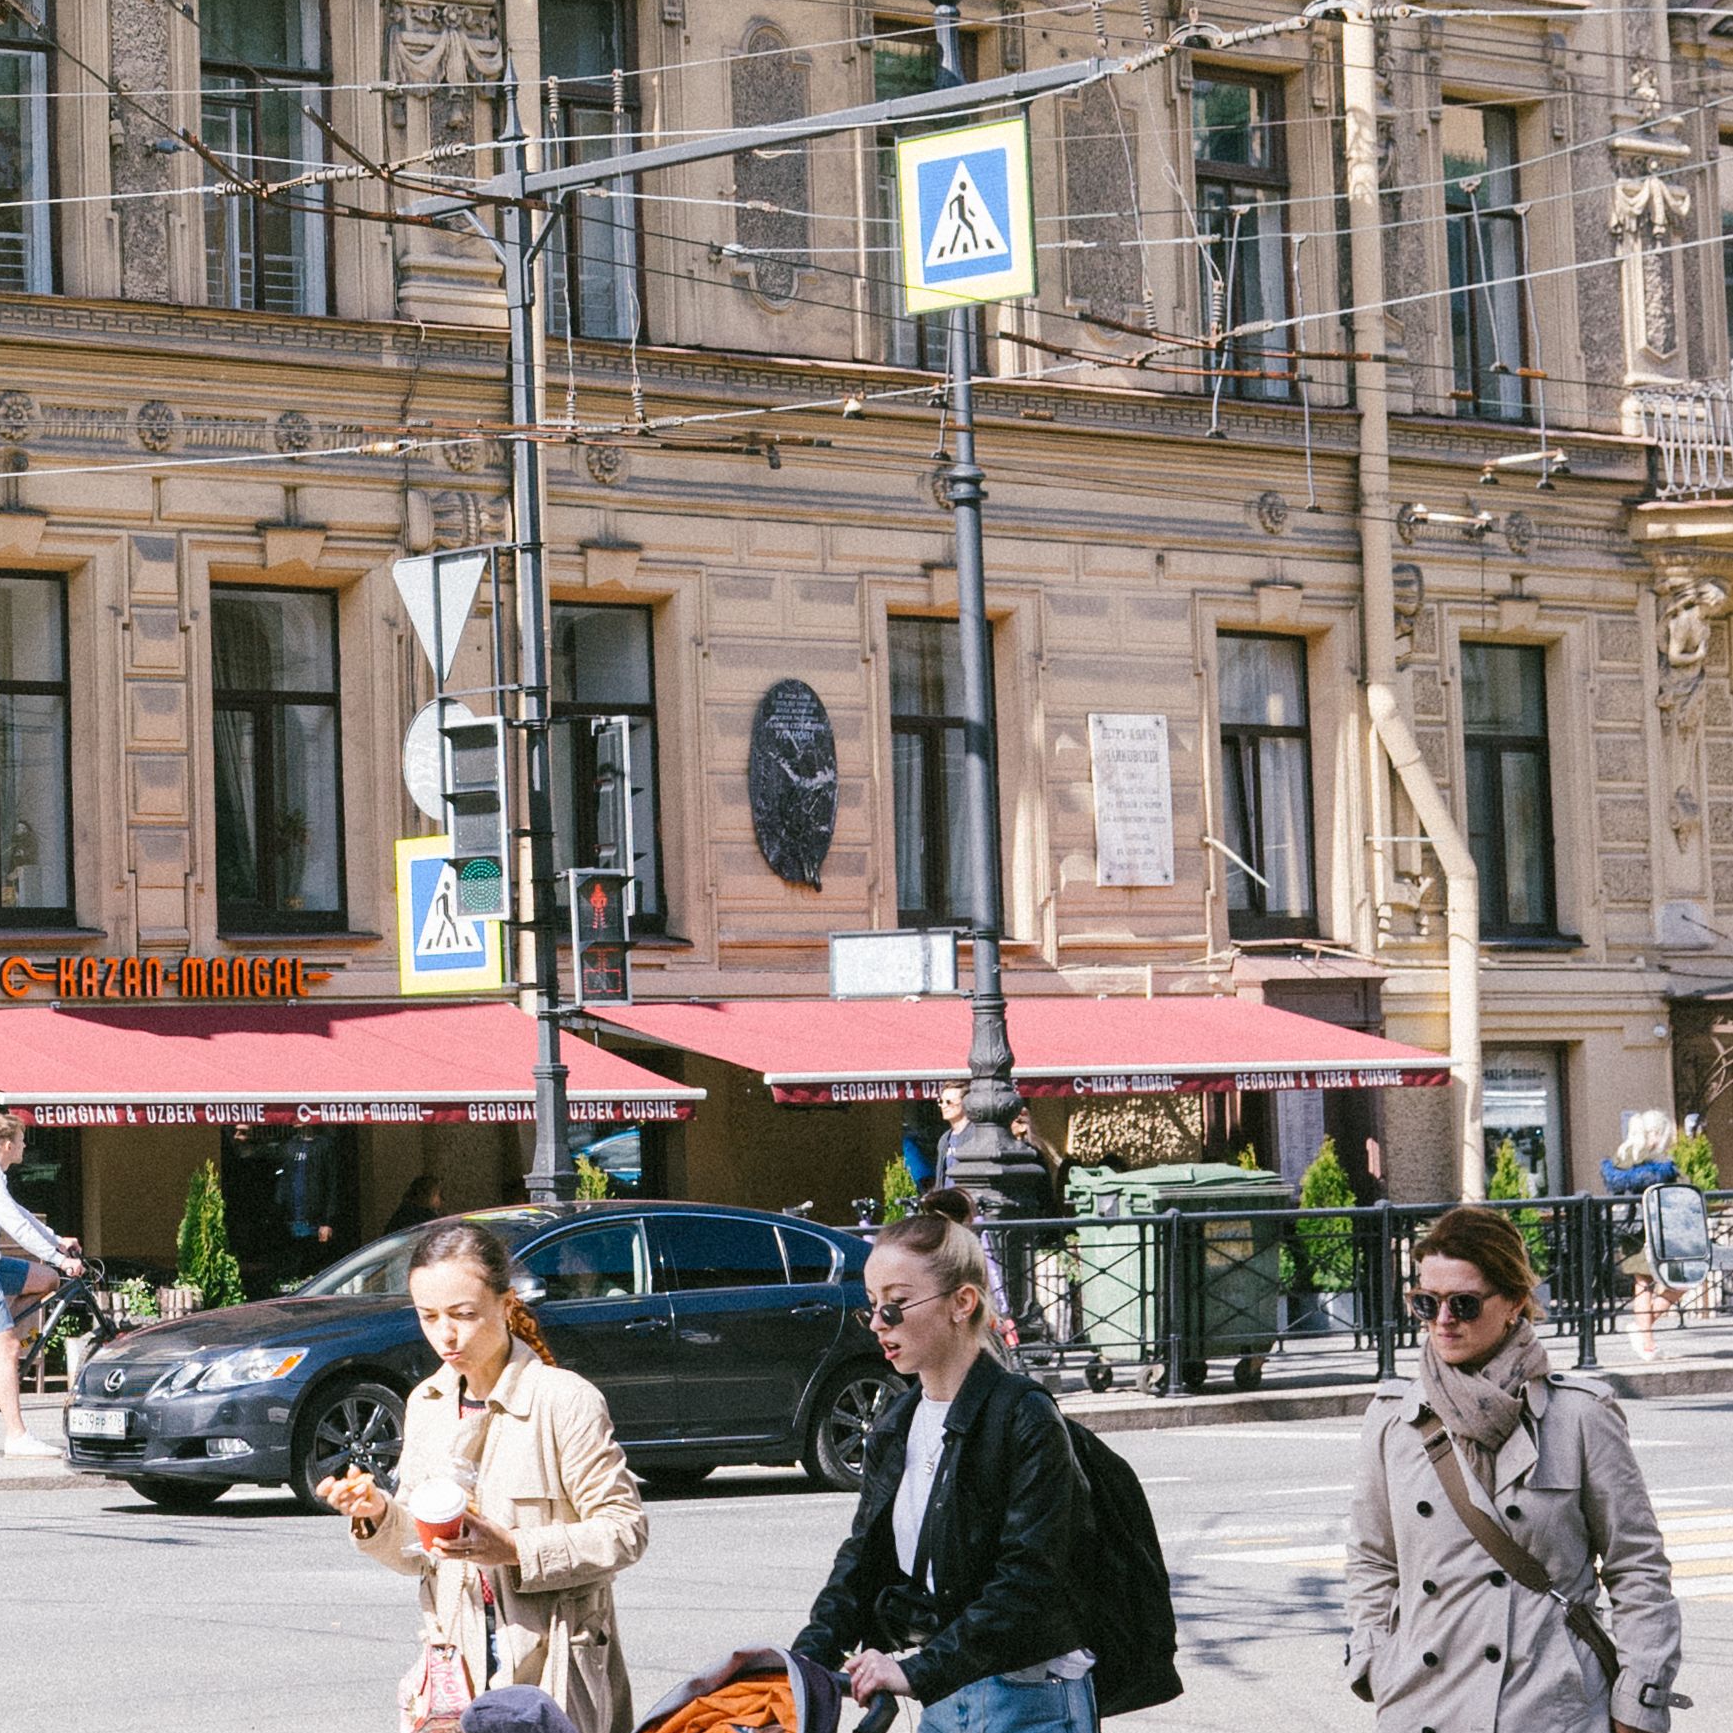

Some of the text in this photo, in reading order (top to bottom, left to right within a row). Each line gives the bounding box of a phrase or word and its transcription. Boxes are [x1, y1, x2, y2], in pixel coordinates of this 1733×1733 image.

[1235, 1069, 1404, 1091] GEORGIAN & UZBEK CUISINE
[831, 1082, 899, 1101] GEORGIAN
[905, 1082, 915, 1100] &
[34, 1103, 266, 1125] GEORGIAN & UZBEK CUISINE
[569, 1101, 615, 1120] UZBEK
[623, 1100, 678, 1119] CUISINE
